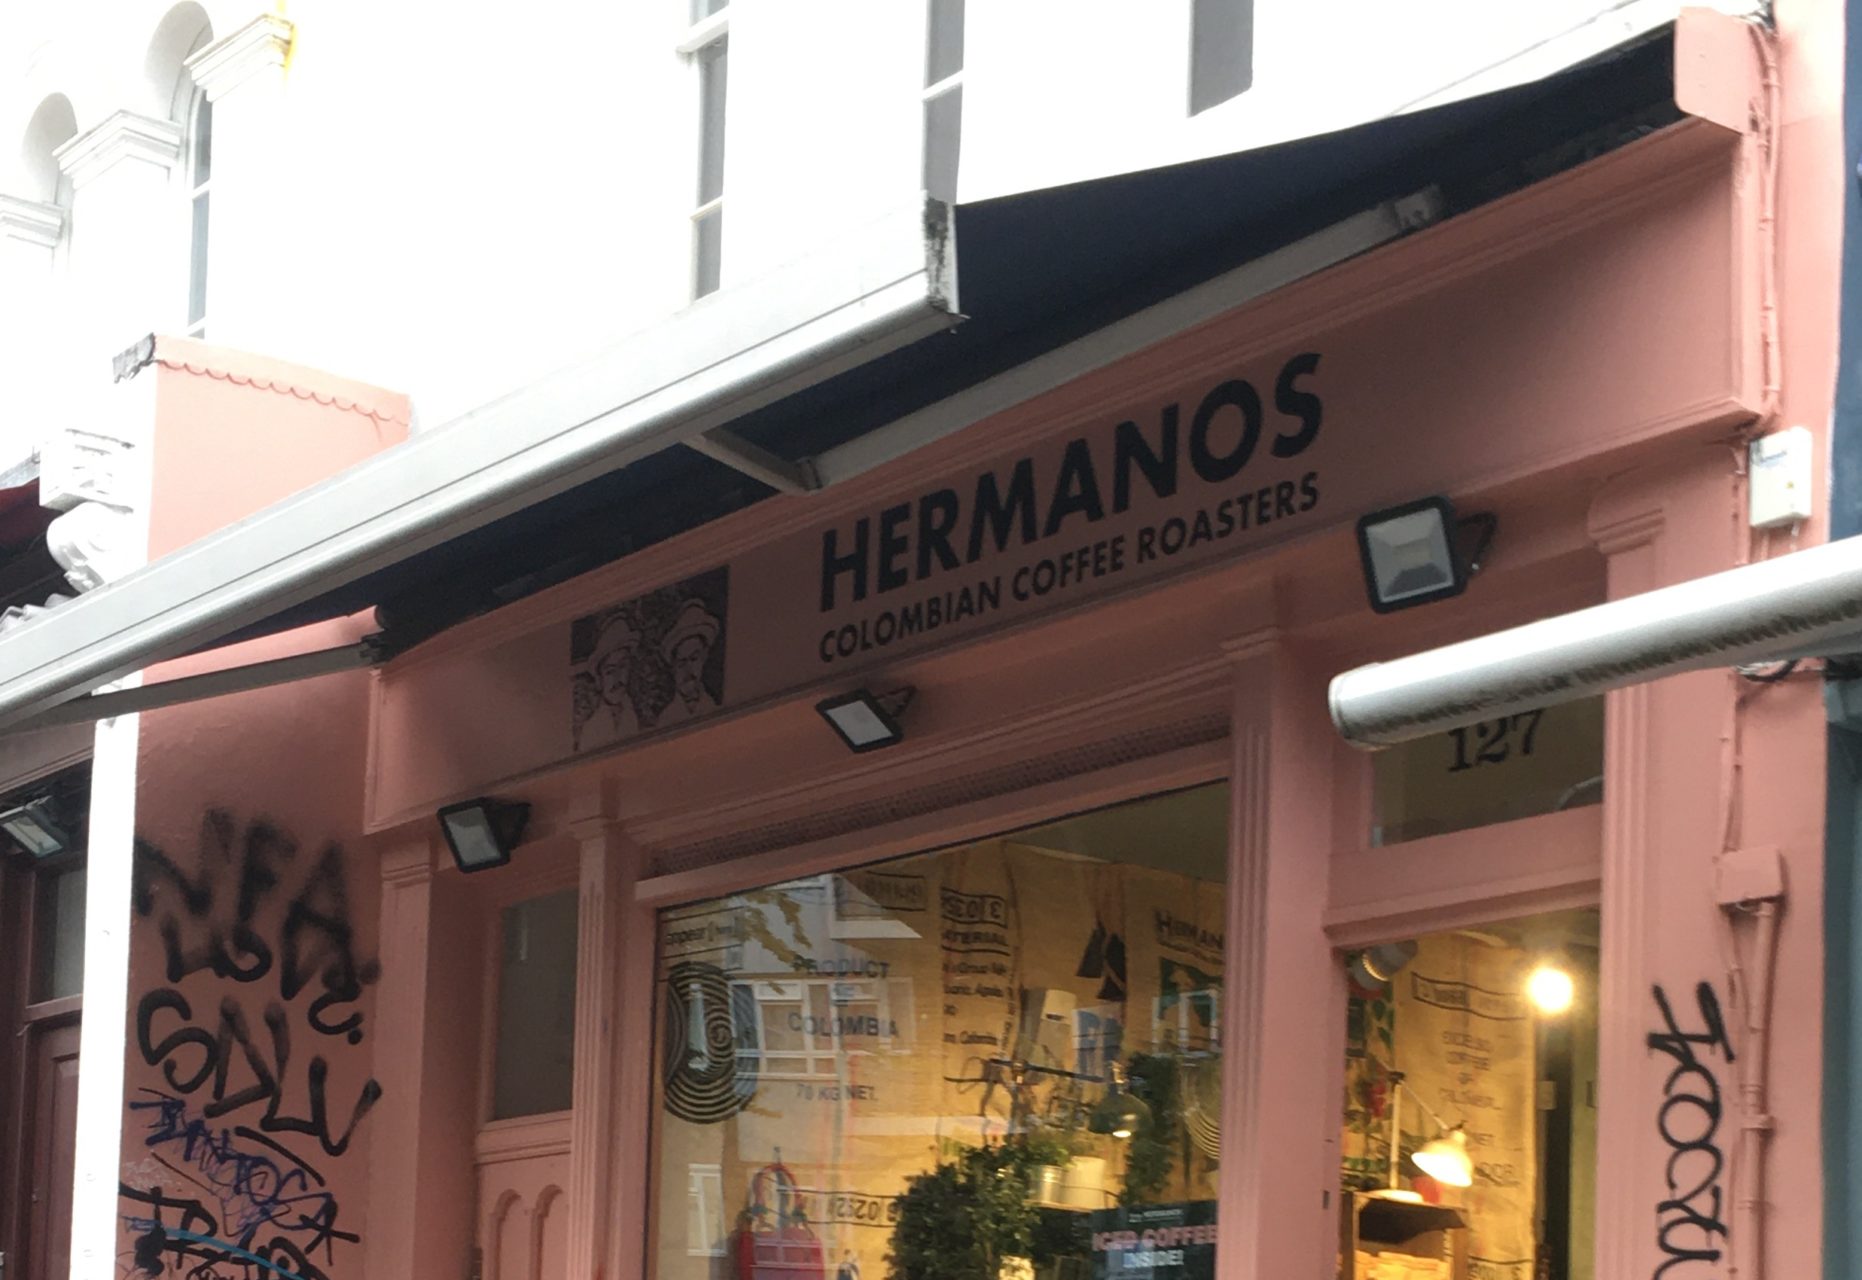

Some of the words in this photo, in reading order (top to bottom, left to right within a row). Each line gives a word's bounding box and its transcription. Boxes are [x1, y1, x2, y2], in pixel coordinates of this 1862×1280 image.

[820, 353, 1322, 612] HERMANOS
[820, 576, 1000, 663] COLOMBIAN
[1013, 535, 1124, 601] COFFEE
[1137, 472, 1318, 564] ROASTERS
[1448, 708, 1546, 772] 127
[788, 1011, 899, 1038] COLOMBIA
[1142, 1225, 1218, 1248] COFFEE
